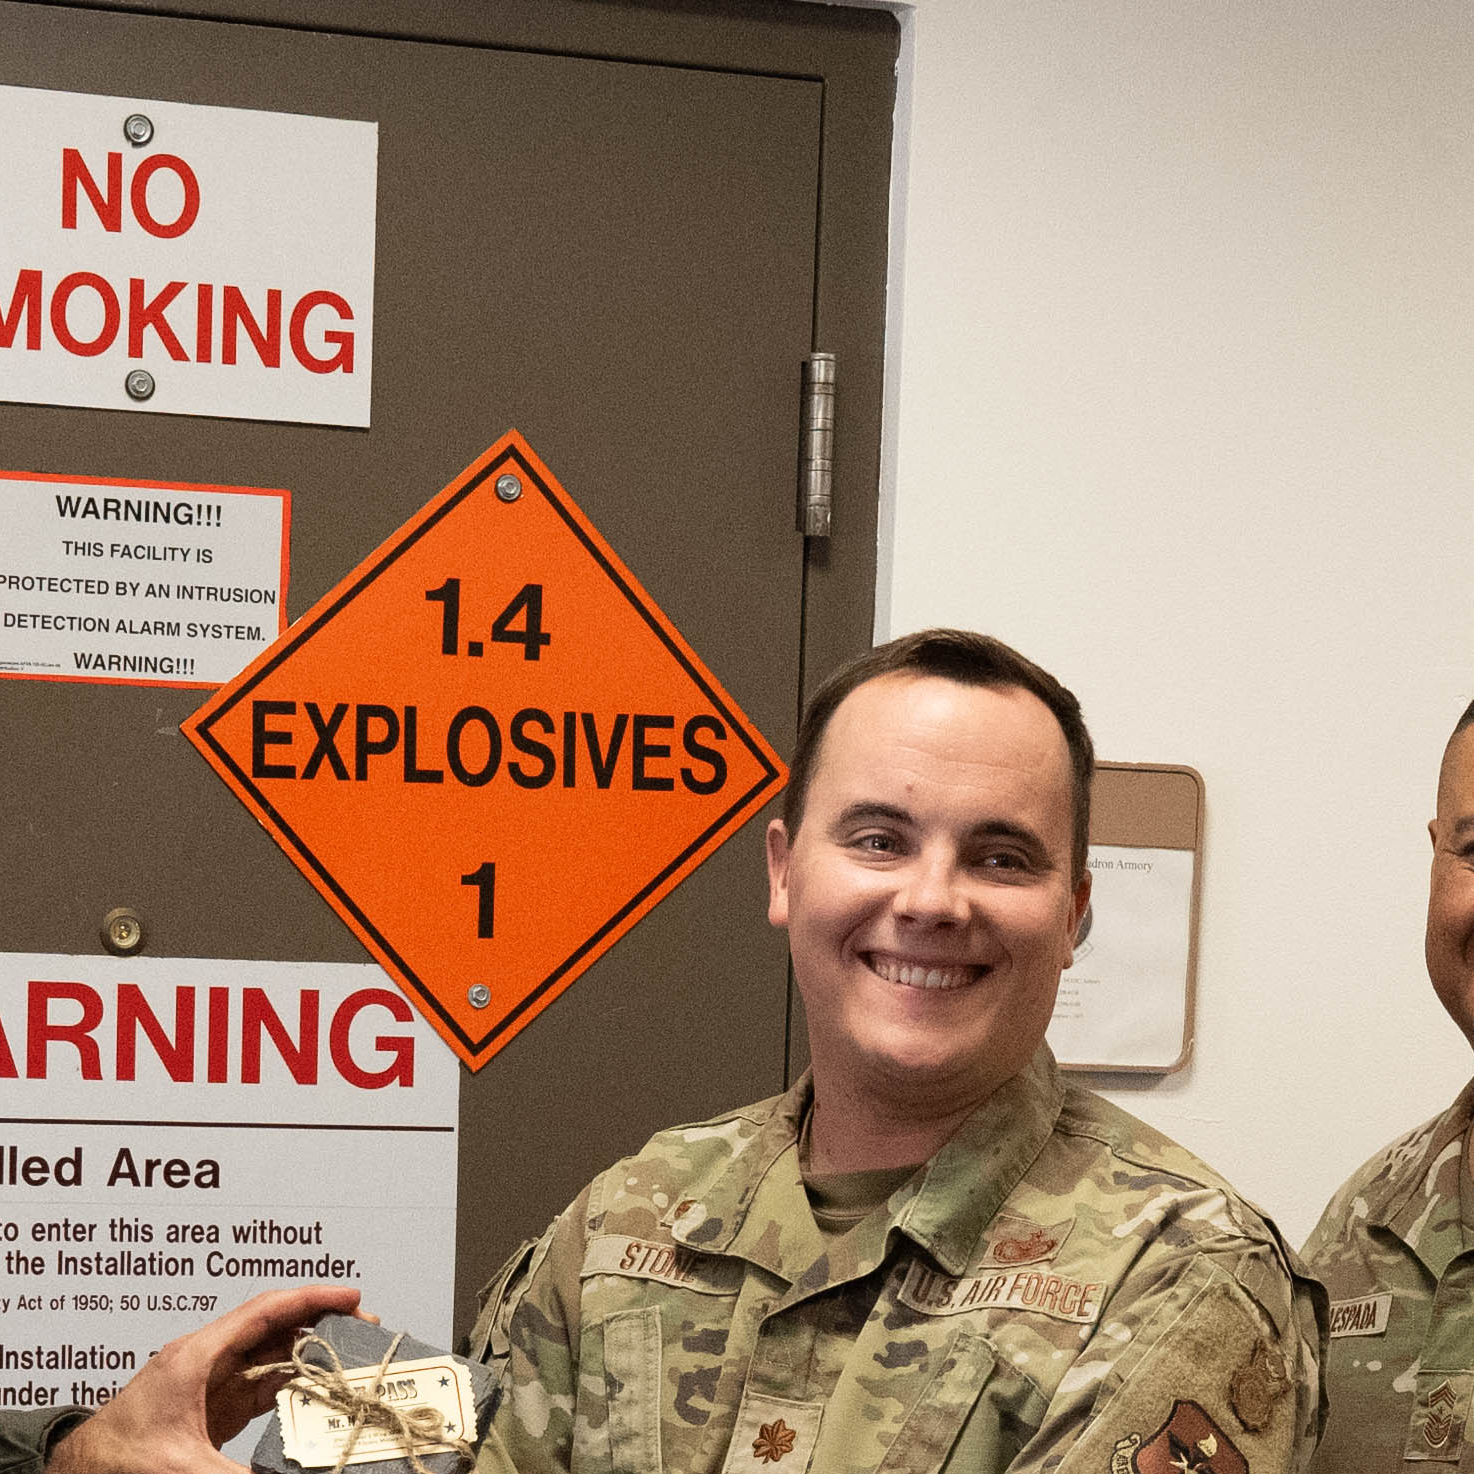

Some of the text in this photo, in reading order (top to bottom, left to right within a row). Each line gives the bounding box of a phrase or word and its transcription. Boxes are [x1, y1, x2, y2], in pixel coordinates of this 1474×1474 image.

[62, 147, 200, 239] NO
[55, 494, 223, 527] WARNING!!!
[62, 540, 214, 564] THIS FACILITY IS
[115, 581, 140, 598] BY
[144, 583, 171, 599] AN
[177, 585, 276, 604] INTRUSION
[3, 613, 266, 641] DETECTION ALARM SYSTEM.
[425, 576, 551, 662] 1.4
[73, 652, 196, 675] WARNING!!!
[250, 700, 728, 796] EXPLOSIVES
[1116, 859, 1154, 873] Armory
[460, 861, 496, 939] 1
[106, 1147, 221, 1189] Area
[31, 1217, 98, 1243] enter
[108, 1216, 154, 1244] this
[165, 1223, 220, 1244] area
[231, 1218, 323, 1246] without
[4, 1249, 46, 1276] the
[57, 1249, 194, 1277] Installation
[206, 1250, 361, 1279] Commander.
[16, 1294, 43, 1311] Act
[49, 1294, 66, 1311] of
[71, 1294, 114, 1314] 1950;
[119, 1294, 141, 1311] 50
[959, 1275, 1007, 1308] AIR
[1007, 1271, 1097, 1317] FORCE
[70, 1380, 125, 1407] thei
